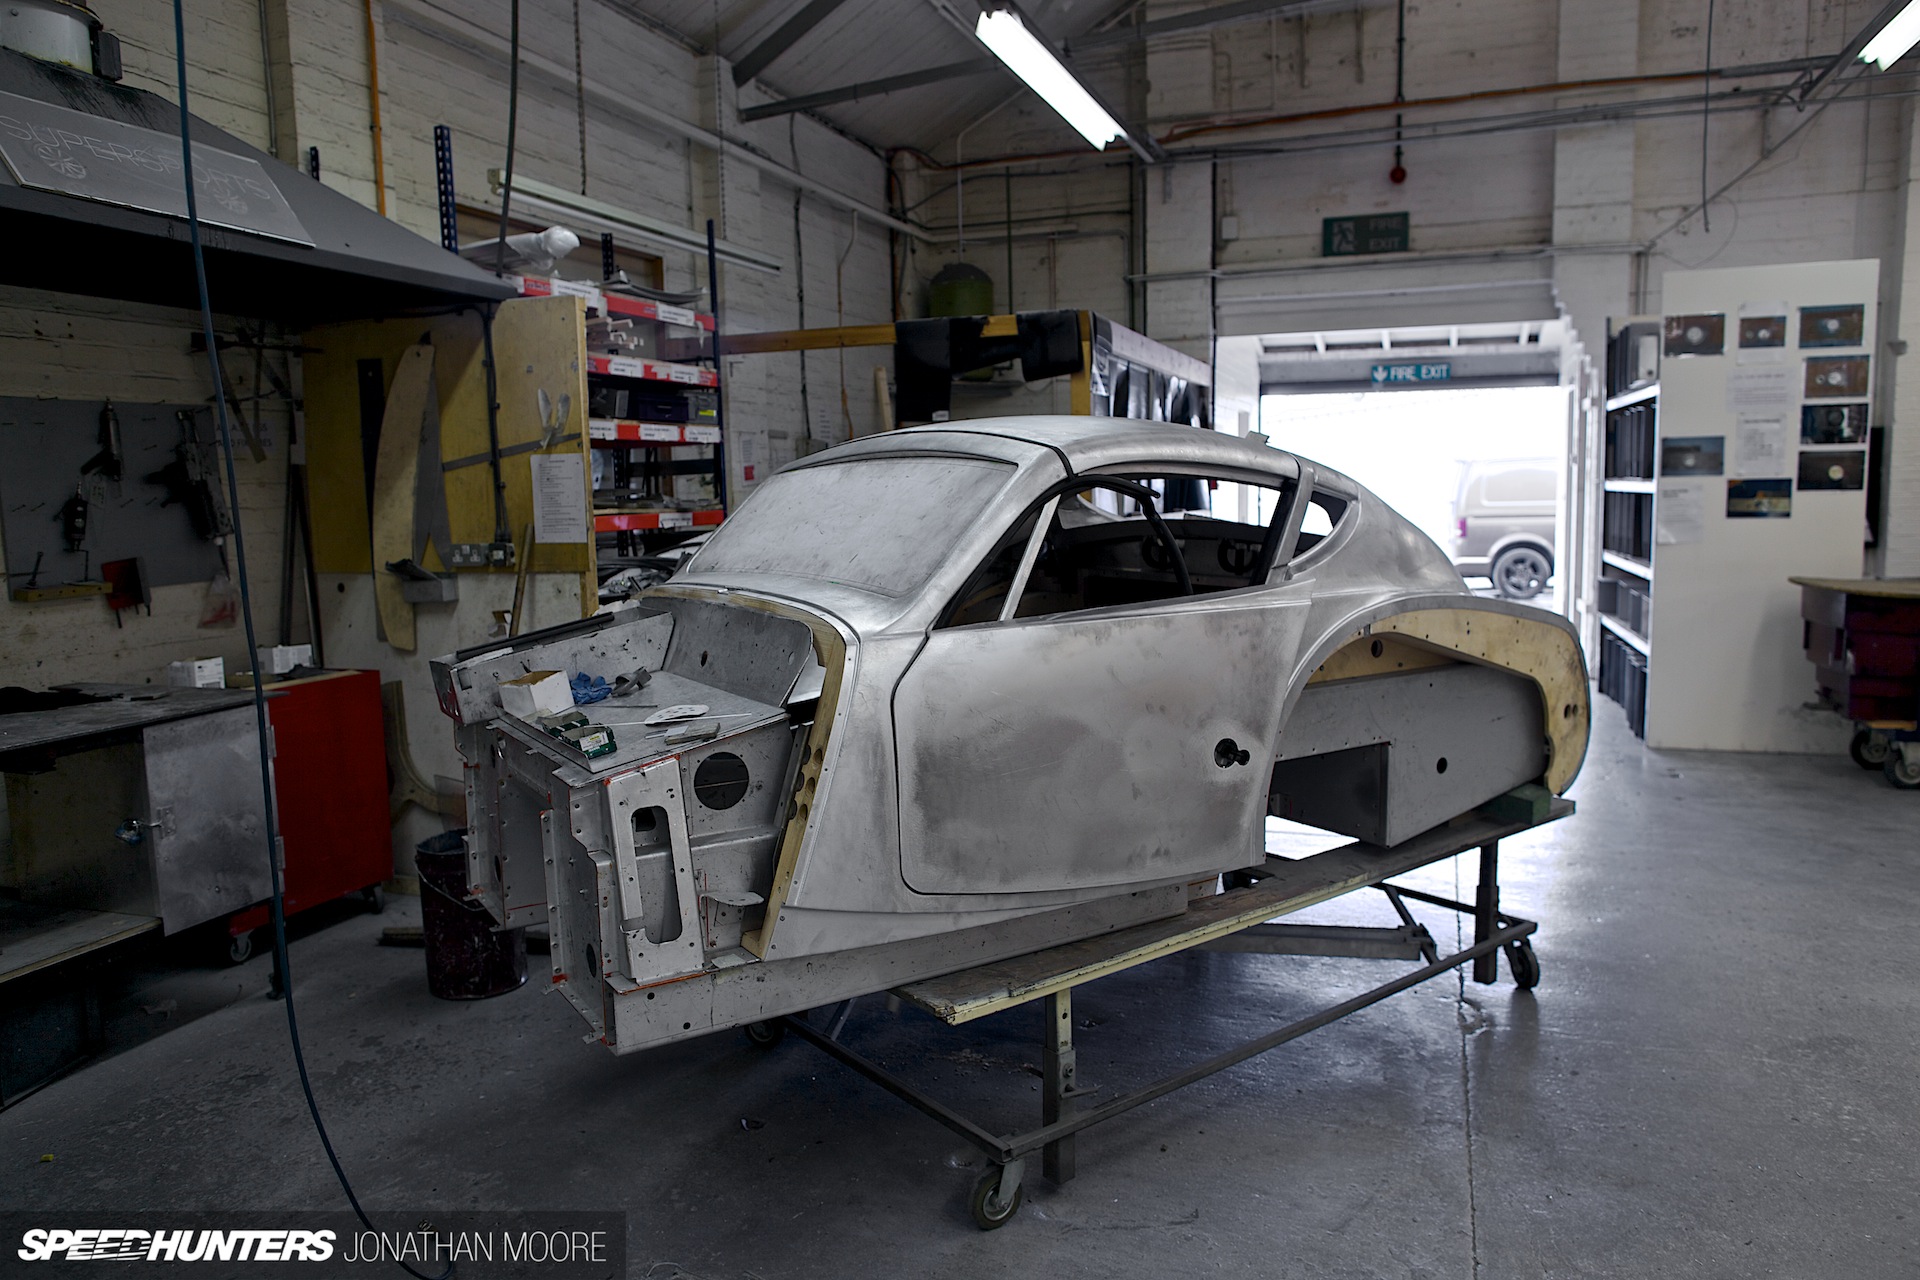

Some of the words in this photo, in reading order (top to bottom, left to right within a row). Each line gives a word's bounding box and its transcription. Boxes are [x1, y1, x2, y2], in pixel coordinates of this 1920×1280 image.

[0, 115, 271, 200] SUPERSPORTS
[1369, 236, 1400, 251] EXIT
[1390, 366, 1416, 381] FIRE
[1421, 364, 1449, 380] EXIT
